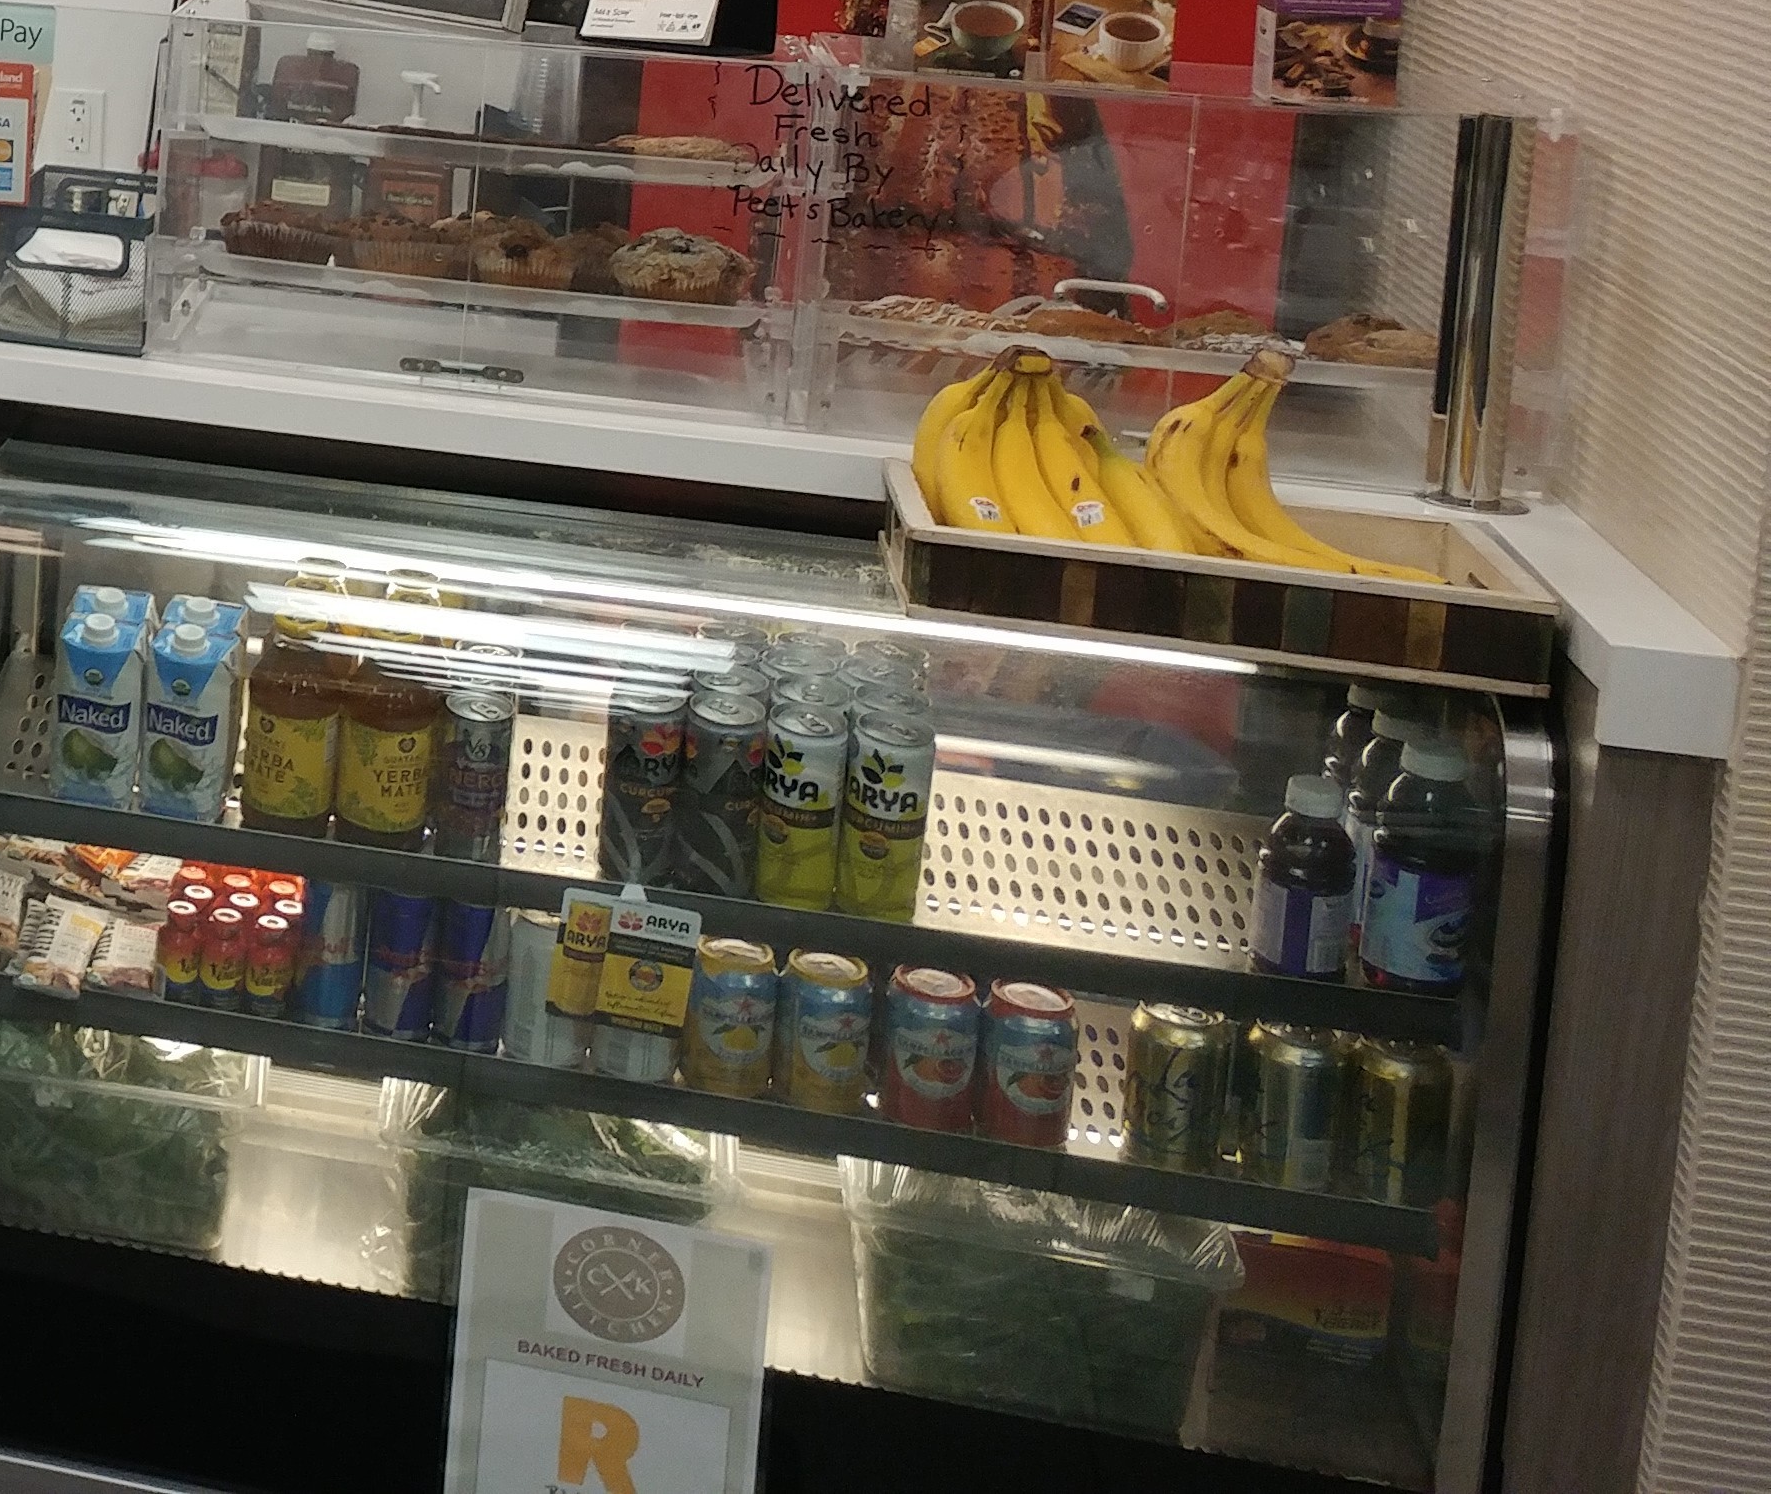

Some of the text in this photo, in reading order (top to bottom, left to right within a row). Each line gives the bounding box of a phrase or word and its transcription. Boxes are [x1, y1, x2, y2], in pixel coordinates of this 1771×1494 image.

[0, 19, 42, 50] Pay
[745, 65, 930, 117] Delivered
[775, 114, 877, 147] Fresh
[731, 142, 894, 195] Daily By
[728, 185, 940, 246] Peet's Bakery
[61, 698, 125, 729] Naked
[148, 708, 209, 740] Naked
[849, 775, 918, 813] ARYA
[567, 929, 608, 946] ARYA
[646, 914, 691, 934] ARYA
[517, 1339, 705, 1389] BAKED FRESH DAILY
